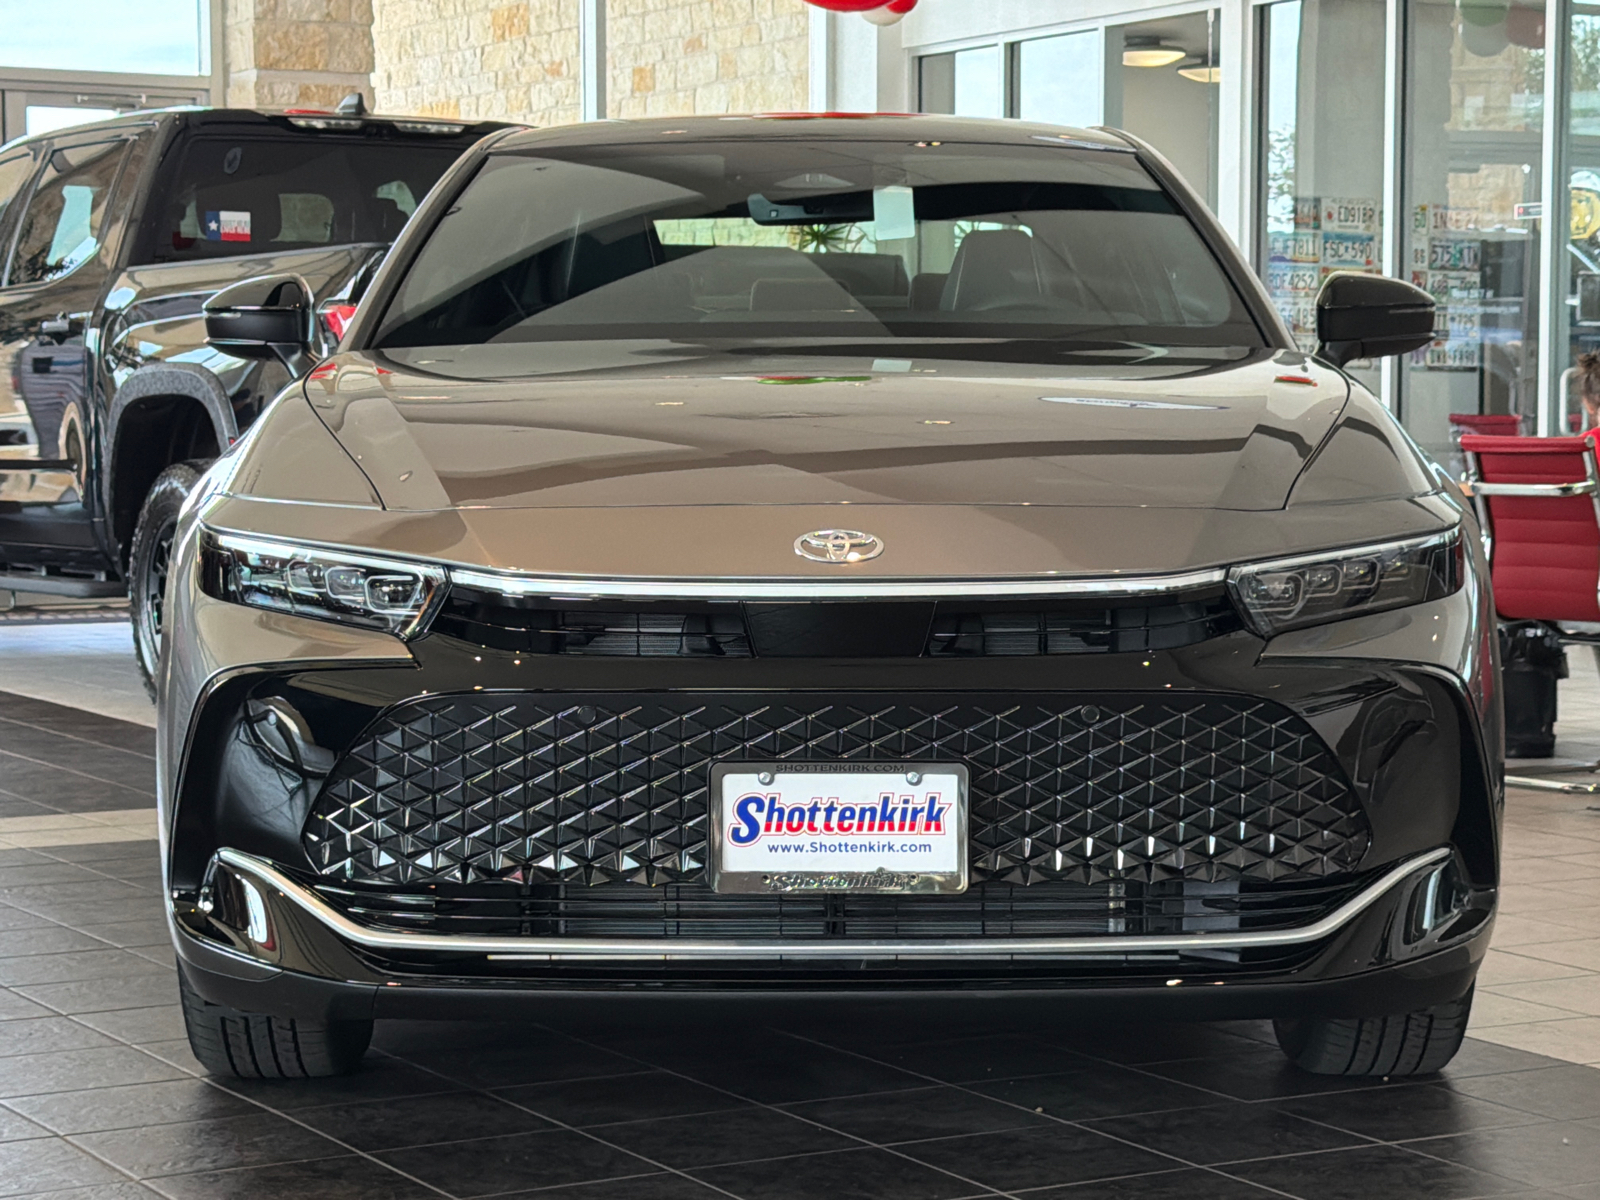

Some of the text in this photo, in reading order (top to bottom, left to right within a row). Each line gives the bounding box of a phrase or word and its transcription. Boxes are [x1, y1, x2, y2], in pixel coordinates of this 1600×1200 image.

[775, 763, 905, 773] SHOTTENKIRK.COM
[729, 794, 950, 846] Shottenkirk
[767, 841, 932, 853] www.Shottenkirk.com
